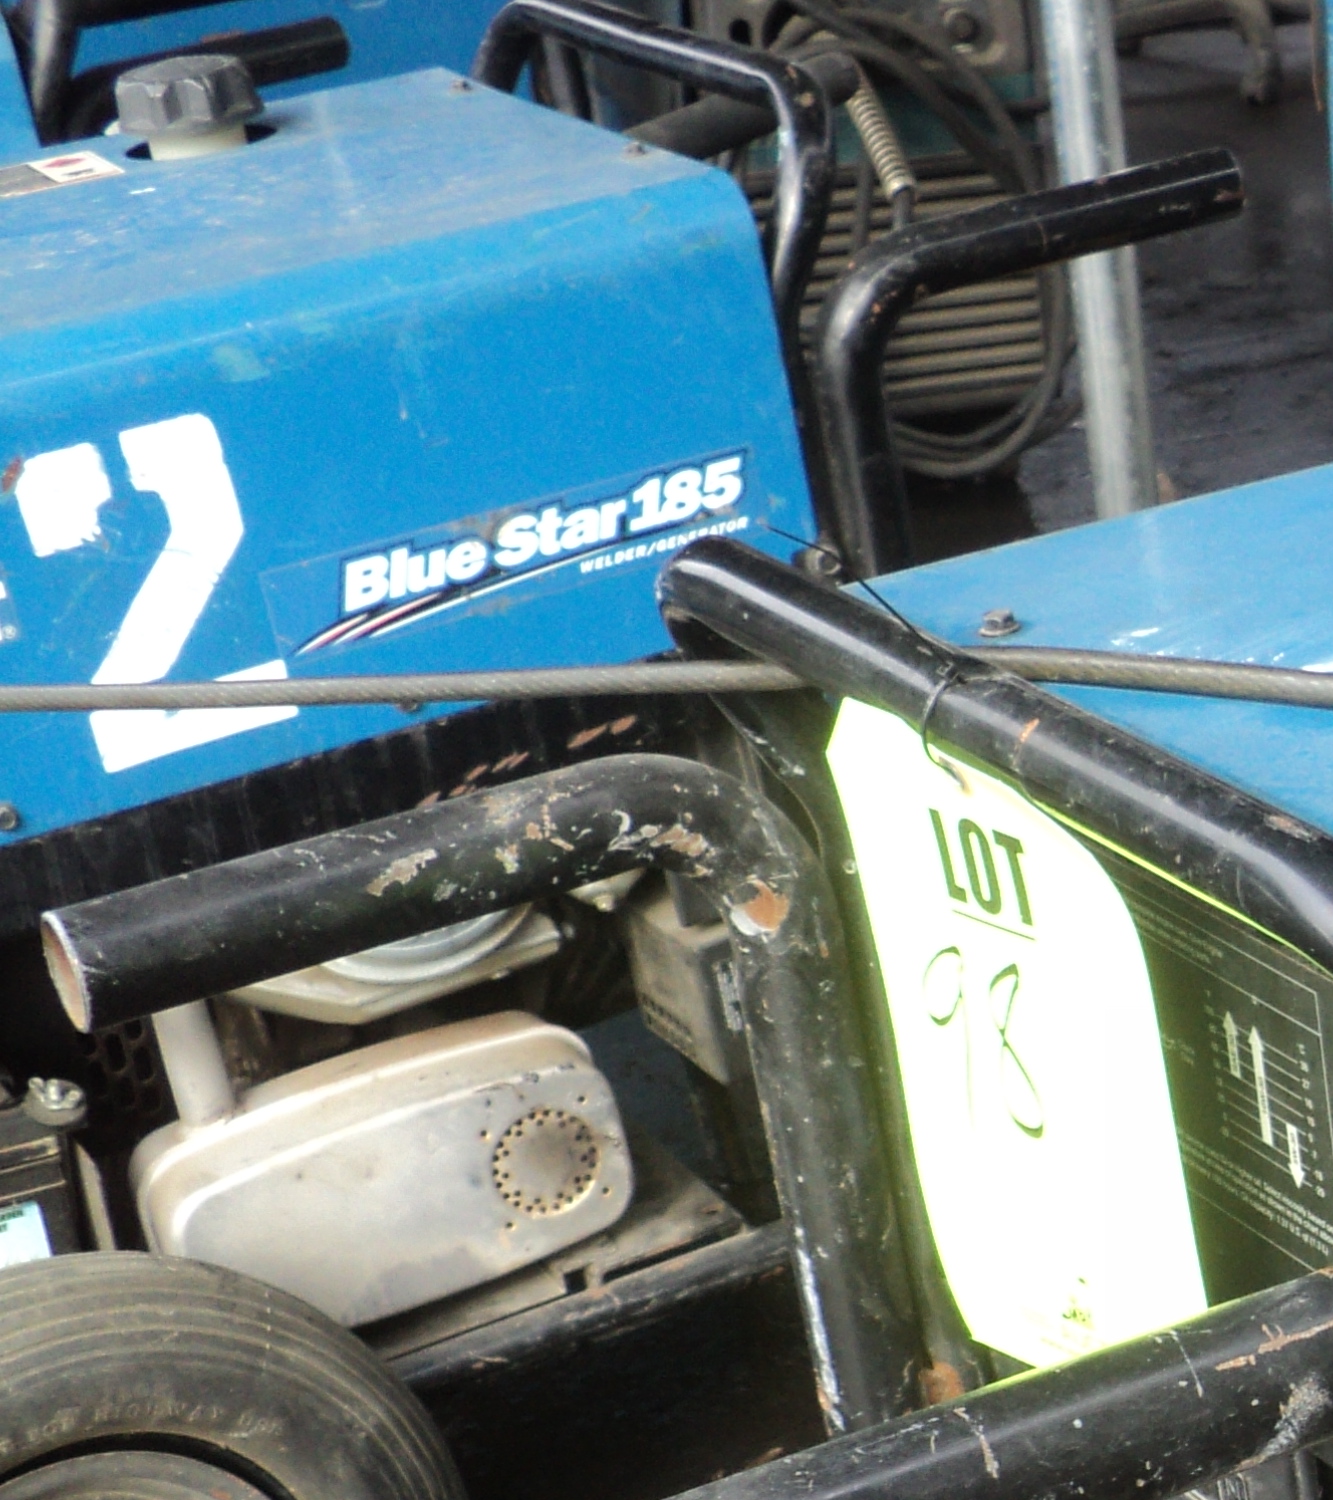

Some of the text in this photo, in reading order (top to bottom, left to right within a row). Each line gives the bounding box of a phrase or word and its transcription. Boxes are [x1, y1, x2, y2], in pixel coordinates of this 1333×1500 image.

[344, 458, 742, 613] Blue Star 185
[929, 807, 1034, 926] LOT
